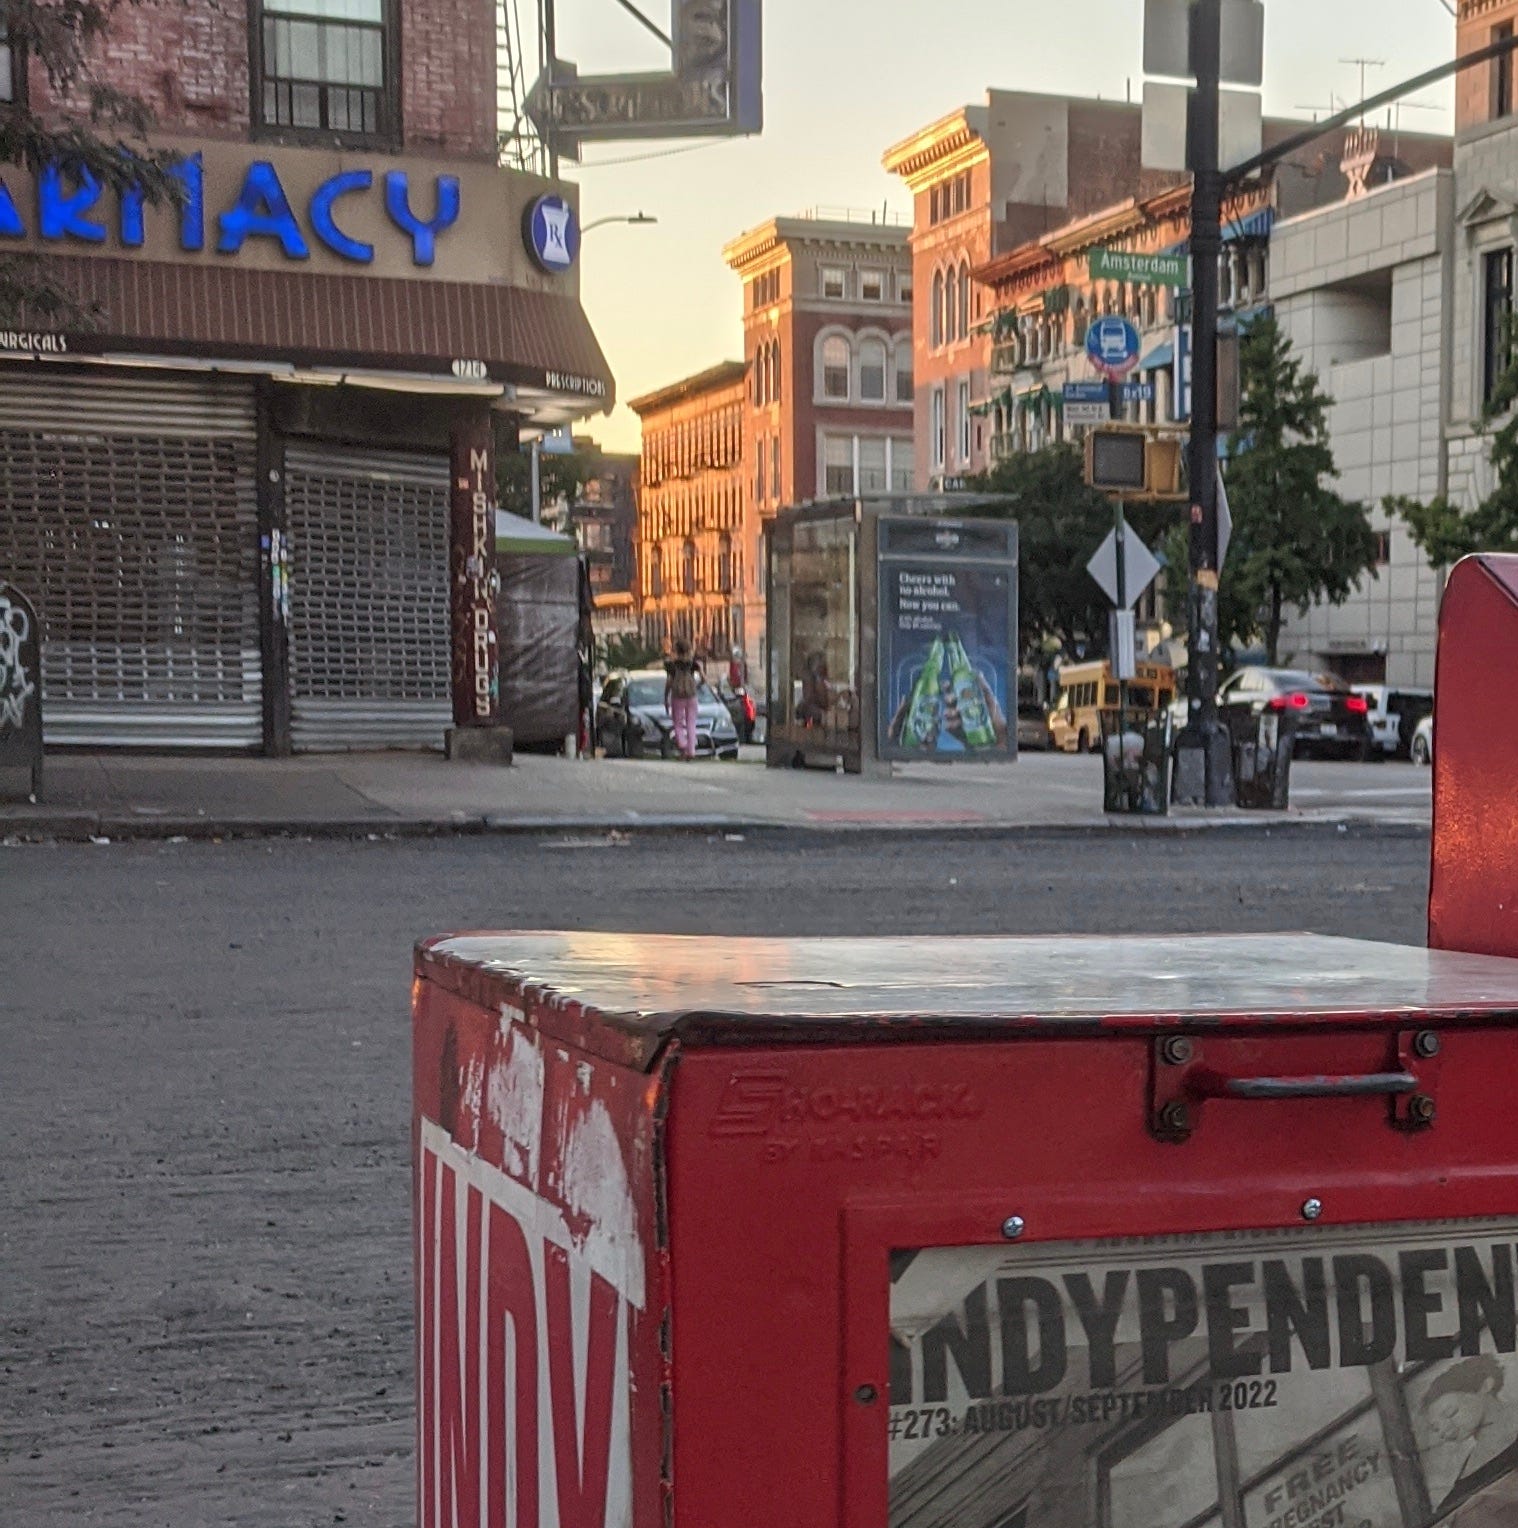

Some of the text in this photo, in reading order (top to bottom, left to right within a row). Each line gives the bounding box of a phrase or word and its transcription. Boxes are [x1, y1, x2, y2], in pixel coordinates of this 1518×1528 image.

[0, 150, 461, 266] RMACY
[1100, 251, 1179, 275] Amsterdam
[545, 371, 606, 396] PRESCRIPTIONS
[474, 608, 491, 716] DRUGS
[1221, 1379, 1278, 1411] 2022
[1264, 1434, 1359, 1516] FREE
